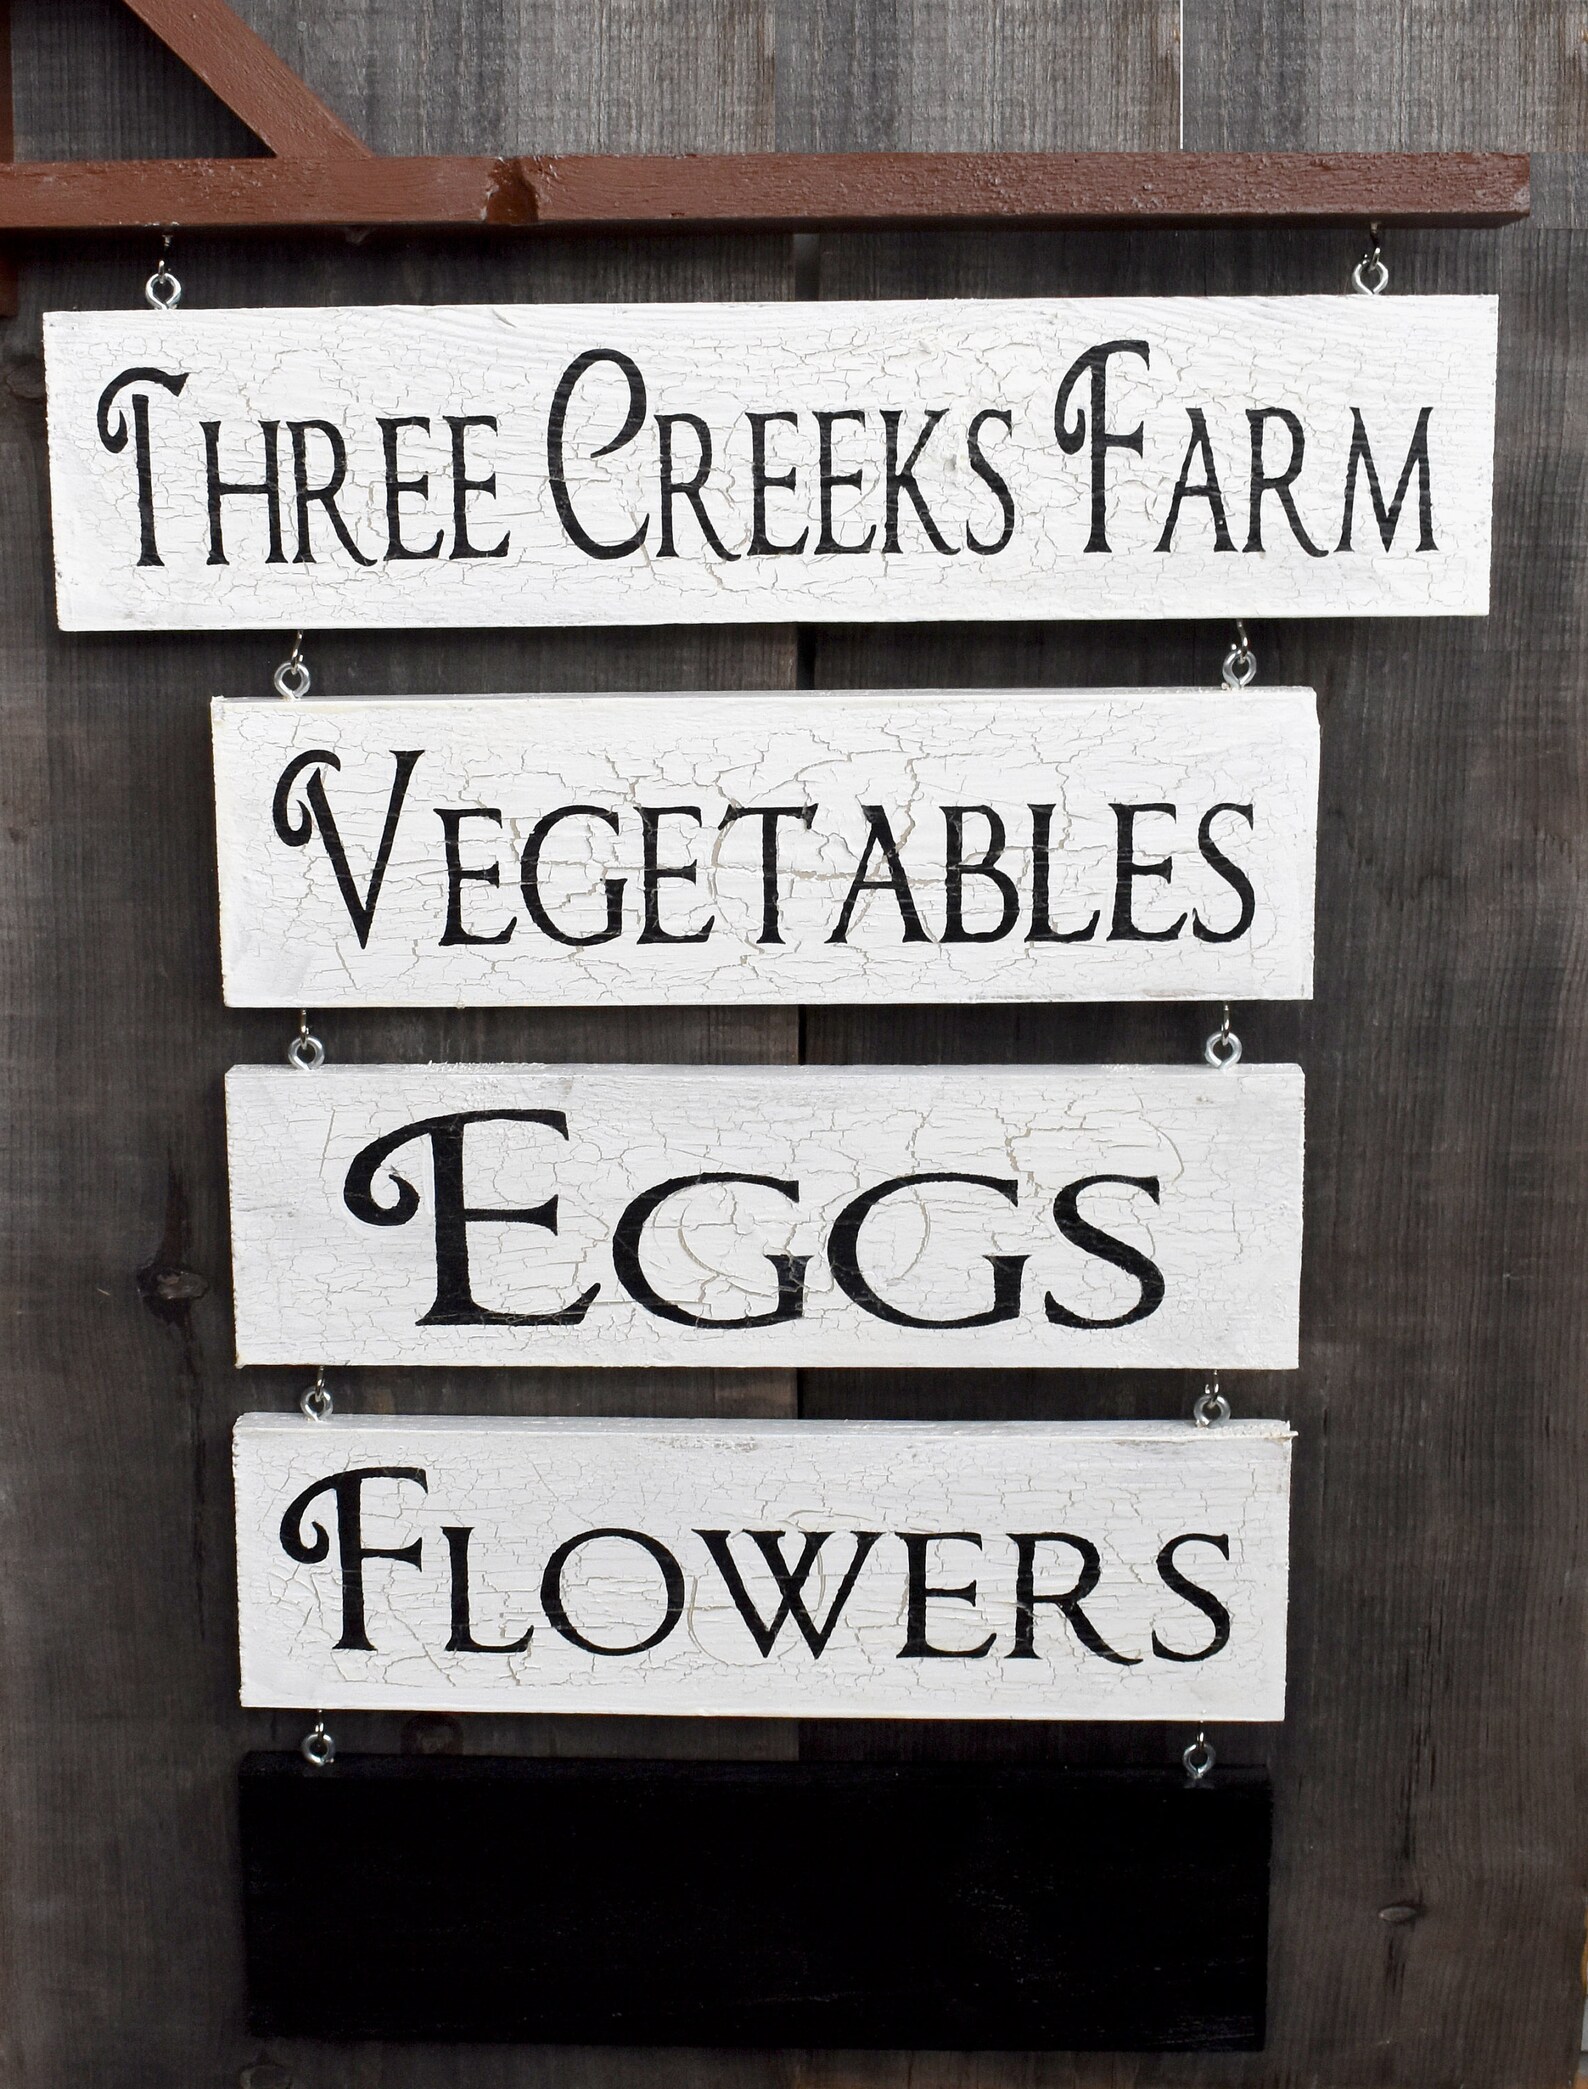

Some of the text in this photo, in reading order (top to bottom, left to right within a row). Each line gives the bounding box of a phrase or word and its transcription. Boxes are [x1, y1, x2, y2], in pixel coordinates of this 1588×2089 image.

[97, 340, 1437, 566] THREE CREEKS FARM
[273, 750, 1255, 949] VEGETABLES
[344, 1109, 1166, 1329] EGGS
[280, 1467, 1231, 1666] FLOWERS
